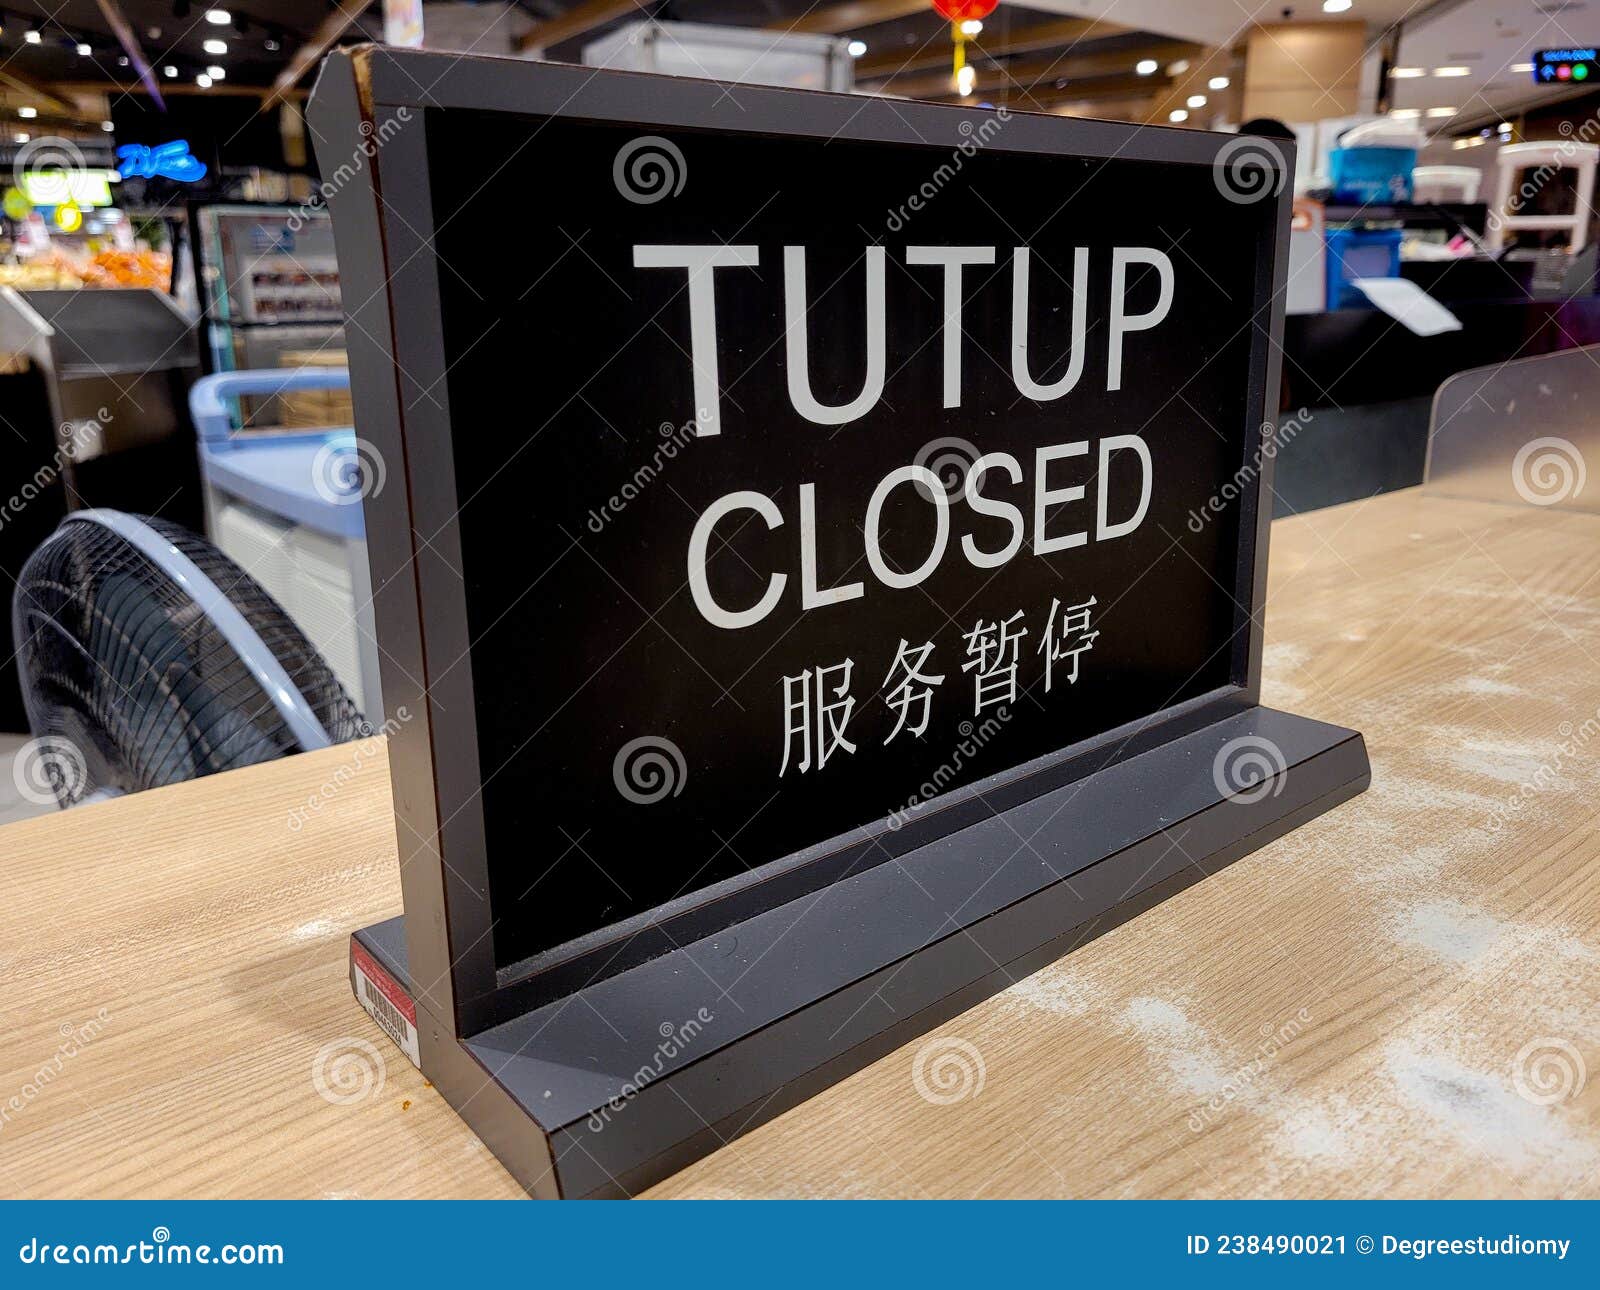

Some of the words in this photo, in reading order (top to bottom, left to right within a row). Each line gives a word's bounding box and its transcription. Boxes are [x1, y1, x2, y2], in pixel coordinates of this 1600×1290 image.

[632, 244, 1175, 438] TUTUP
[687, 434, 1153, 630] CLOSED
[778, 594, 1101, 778] 服务暂停
